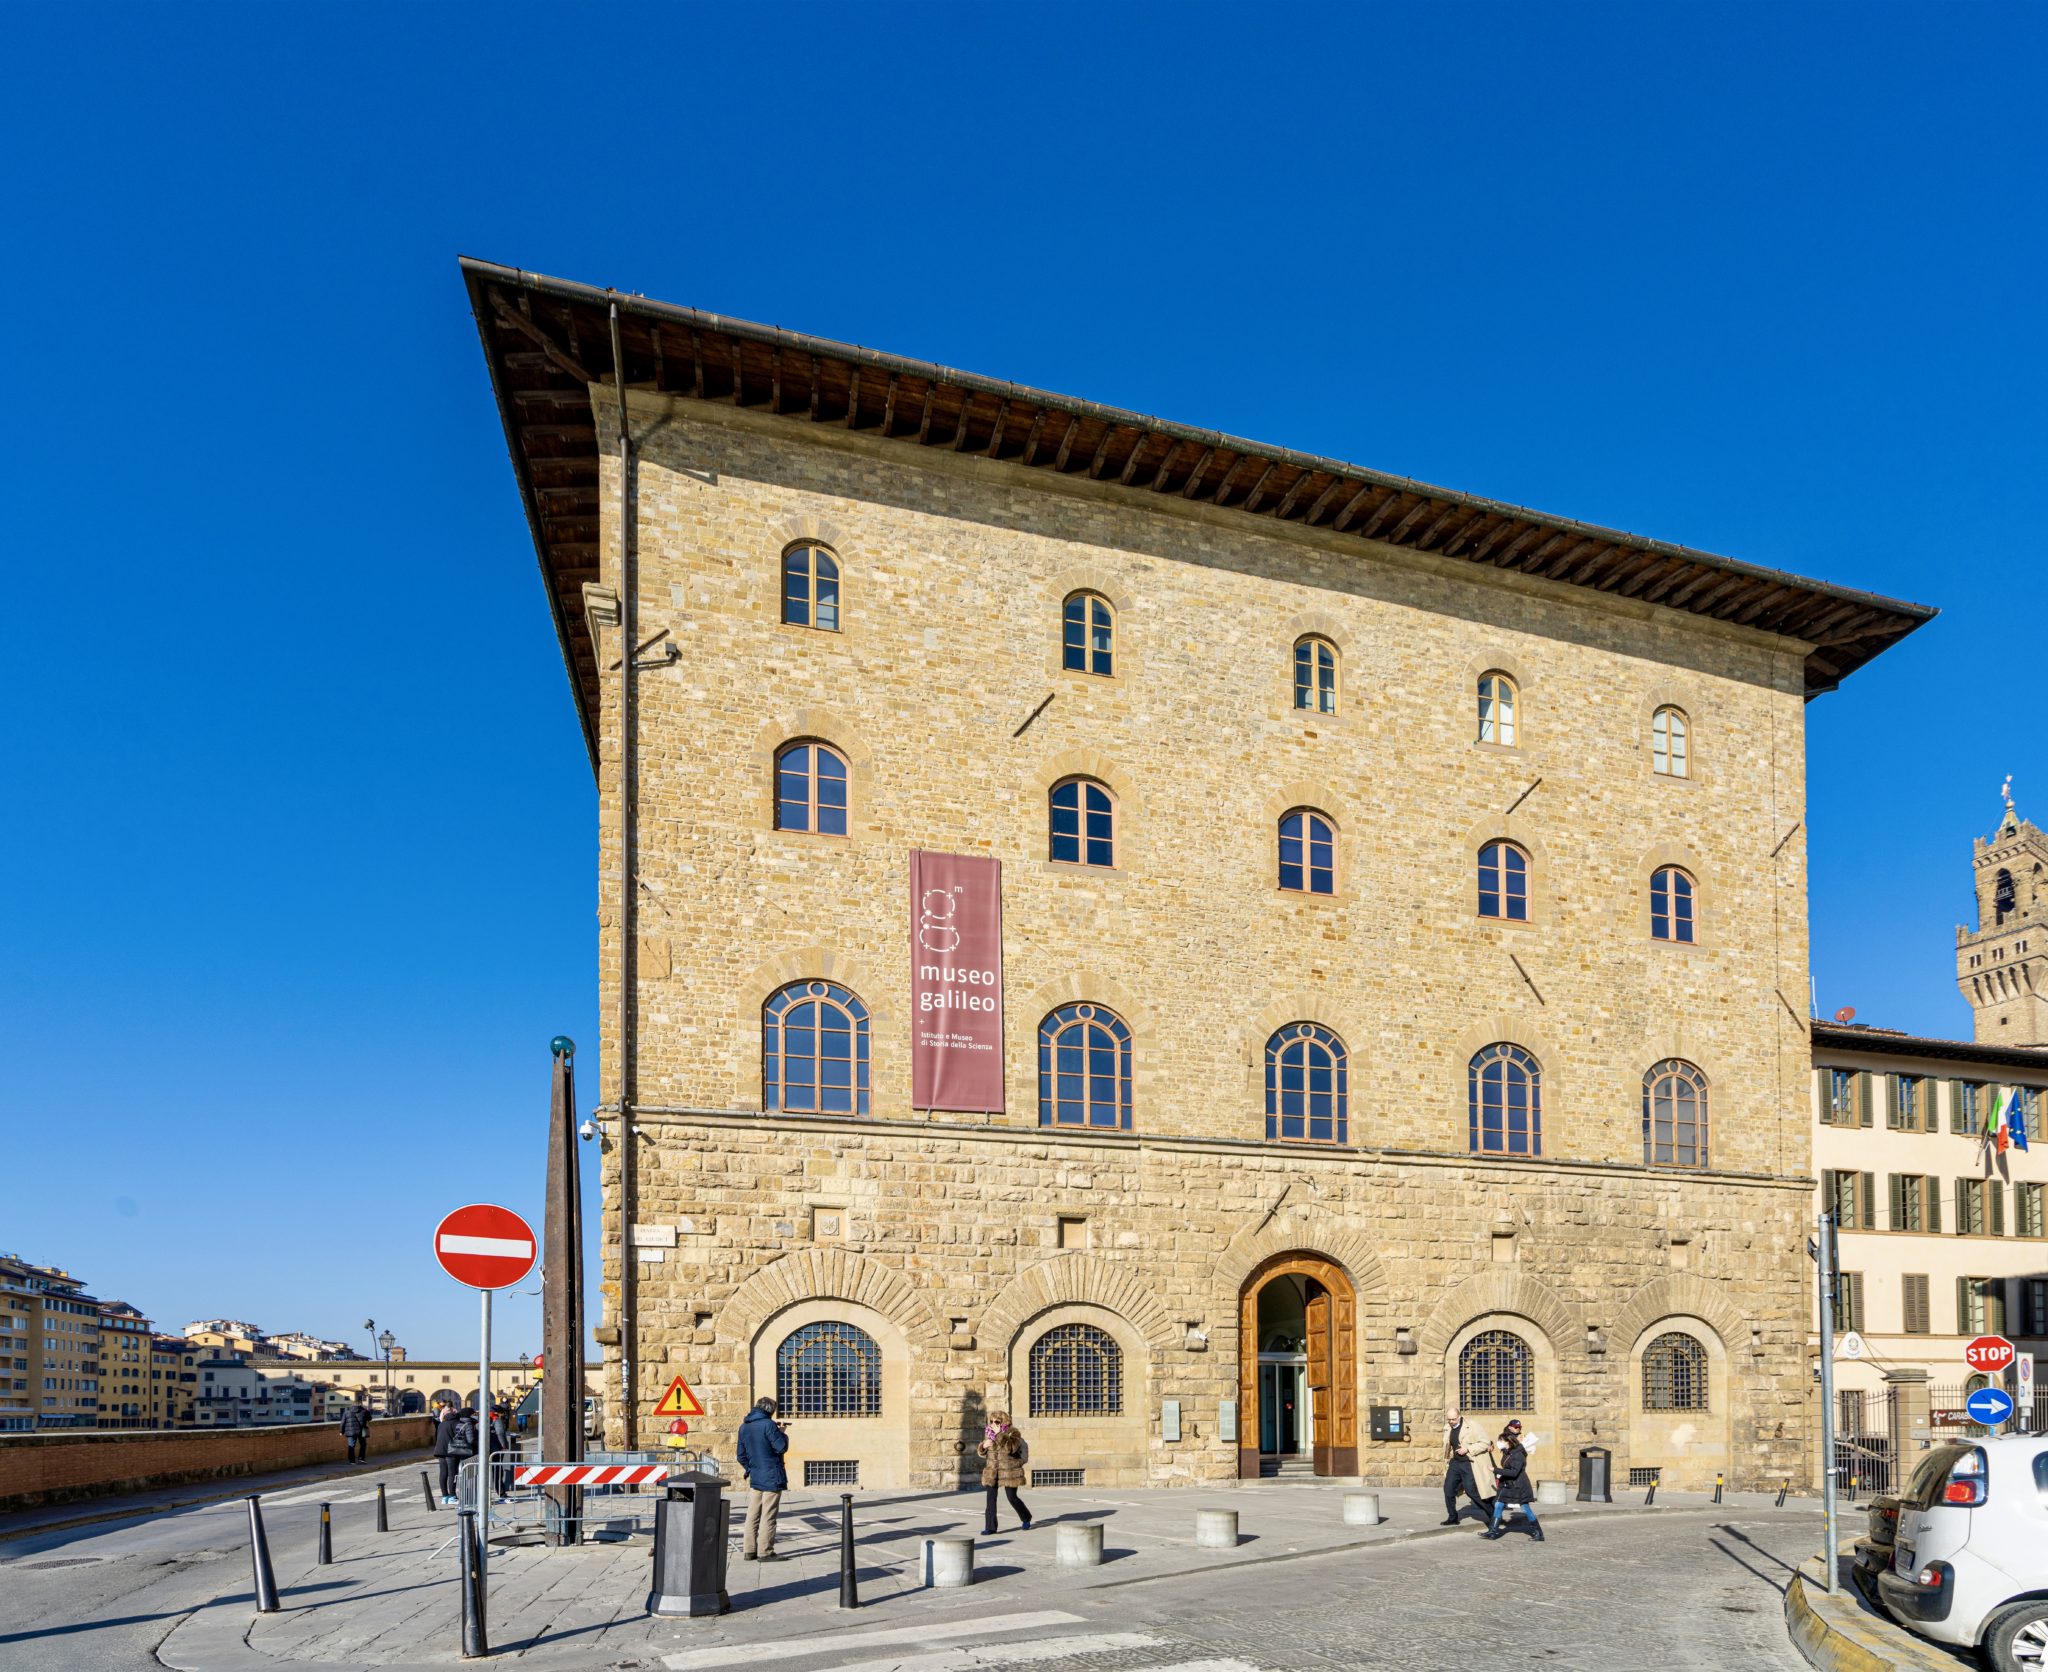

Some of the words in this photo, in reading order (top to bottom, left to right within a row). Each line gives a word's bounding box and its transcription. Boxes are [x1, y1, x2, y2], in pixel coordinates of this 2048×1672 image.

[920, 965, 995, 986] museo
[920, 989, 995, 1012] galileo
[921, 1031, 944, 1040] Istituto
[951, 1033, 973, 1042] Museo
[950, 1041, 967, 1049] della
[968, 1042, 993, 1051] Scienza
[1967, 1346, 2011, 1362] STOP
